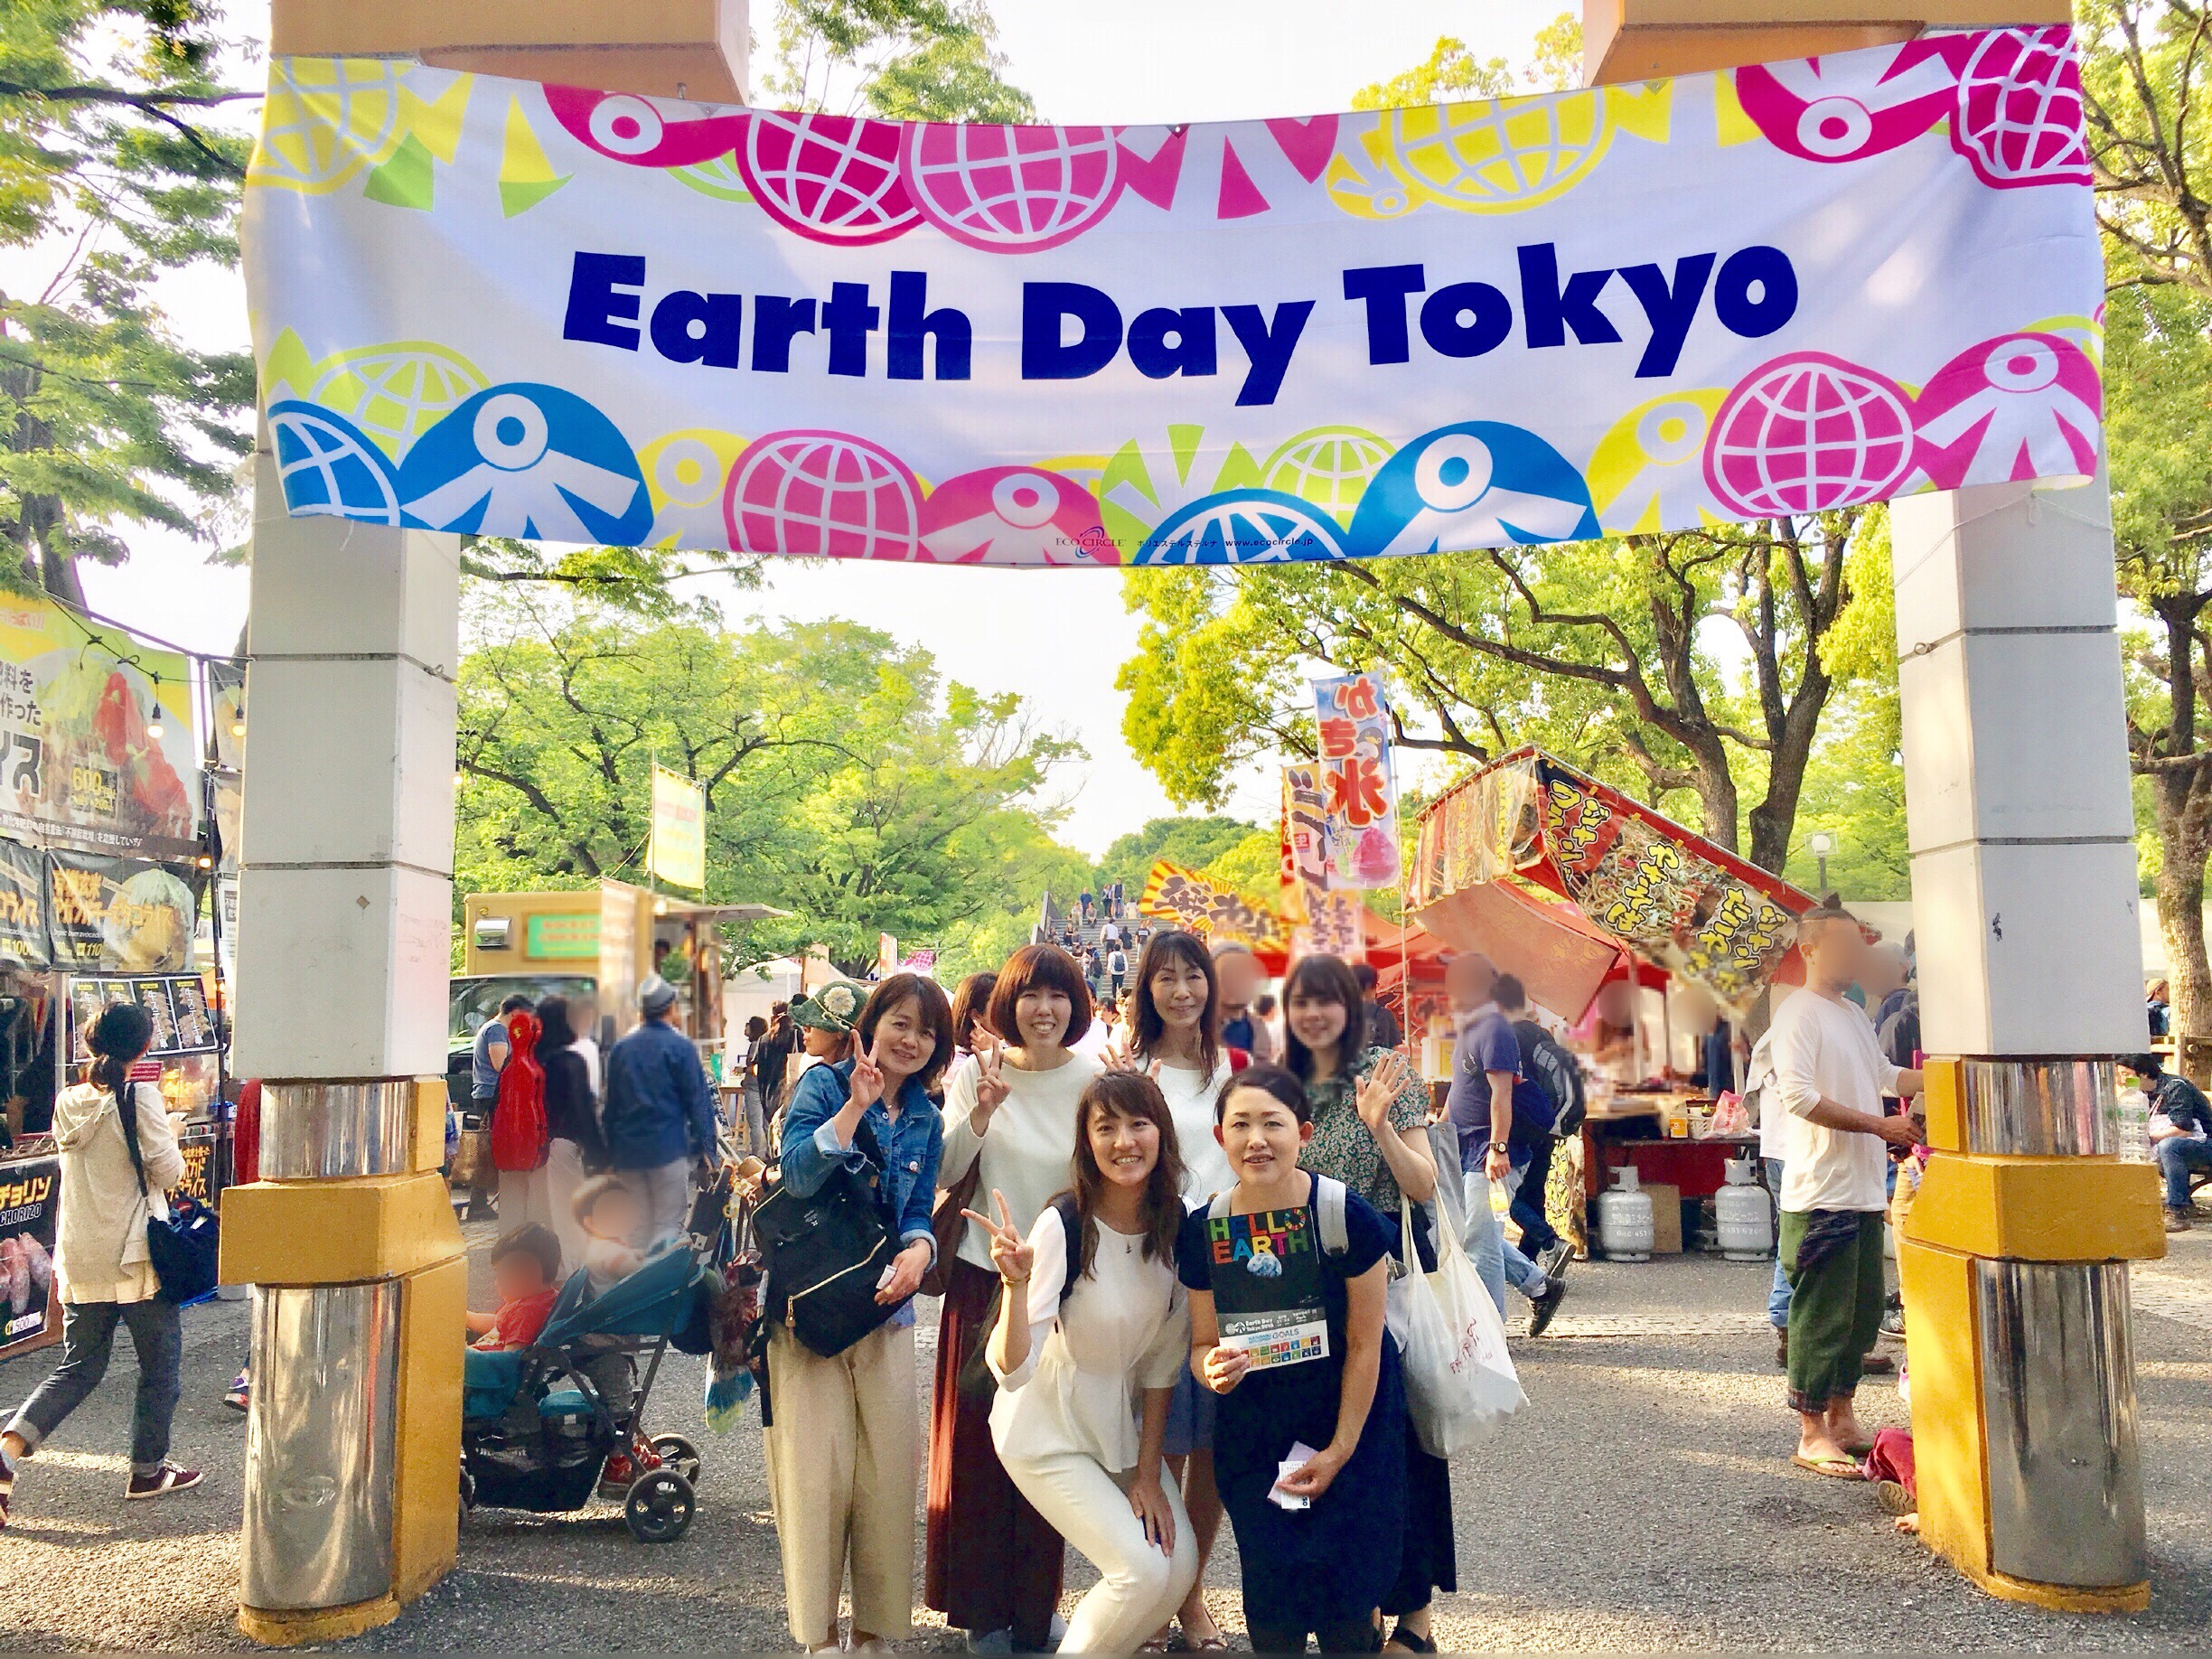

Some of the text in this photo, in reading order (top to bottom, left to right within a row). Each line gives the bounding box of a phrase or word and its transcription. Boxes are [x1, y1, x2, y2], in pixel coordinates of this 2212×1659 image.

[562, 241, 1798, 407] Earth Day Tokyo
[1055, 538, 1125, 548] ECO CIRCLE
[1224, 537, 1314, 547] www.ecocircle.jp
[0, 661, 33, 695] 料を
[1605, 841, 1681, 933] やきそば
[0, 1203, 42, 1227] CHORIZO
[1208, 1206, 1307, 1242] HELLO
[1212, 1229, 1309, 1265] EARTH
[1272, 1328, 1299, 1340] GOALS
